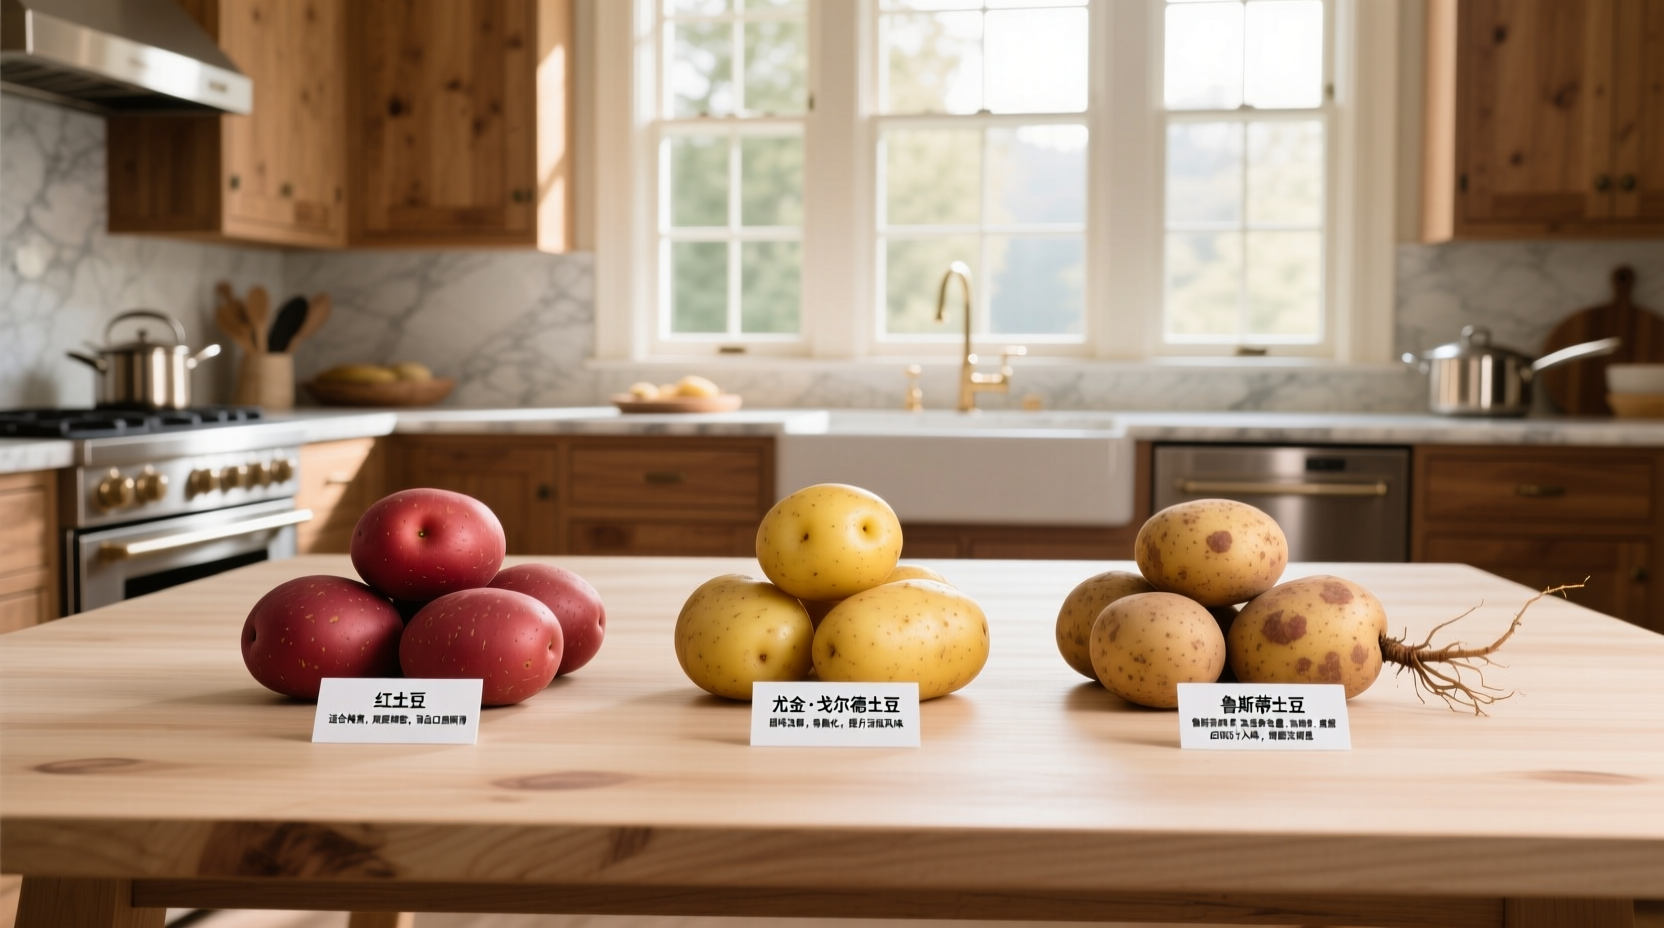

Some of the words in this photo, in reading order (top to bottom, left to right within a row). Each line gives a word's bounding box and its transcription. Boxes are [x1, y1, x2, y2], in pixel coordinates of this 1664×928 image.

[373, 691, 426, 709] 红土豆
[772, 694, 901, 714] 尤金·戈尔德土豆
